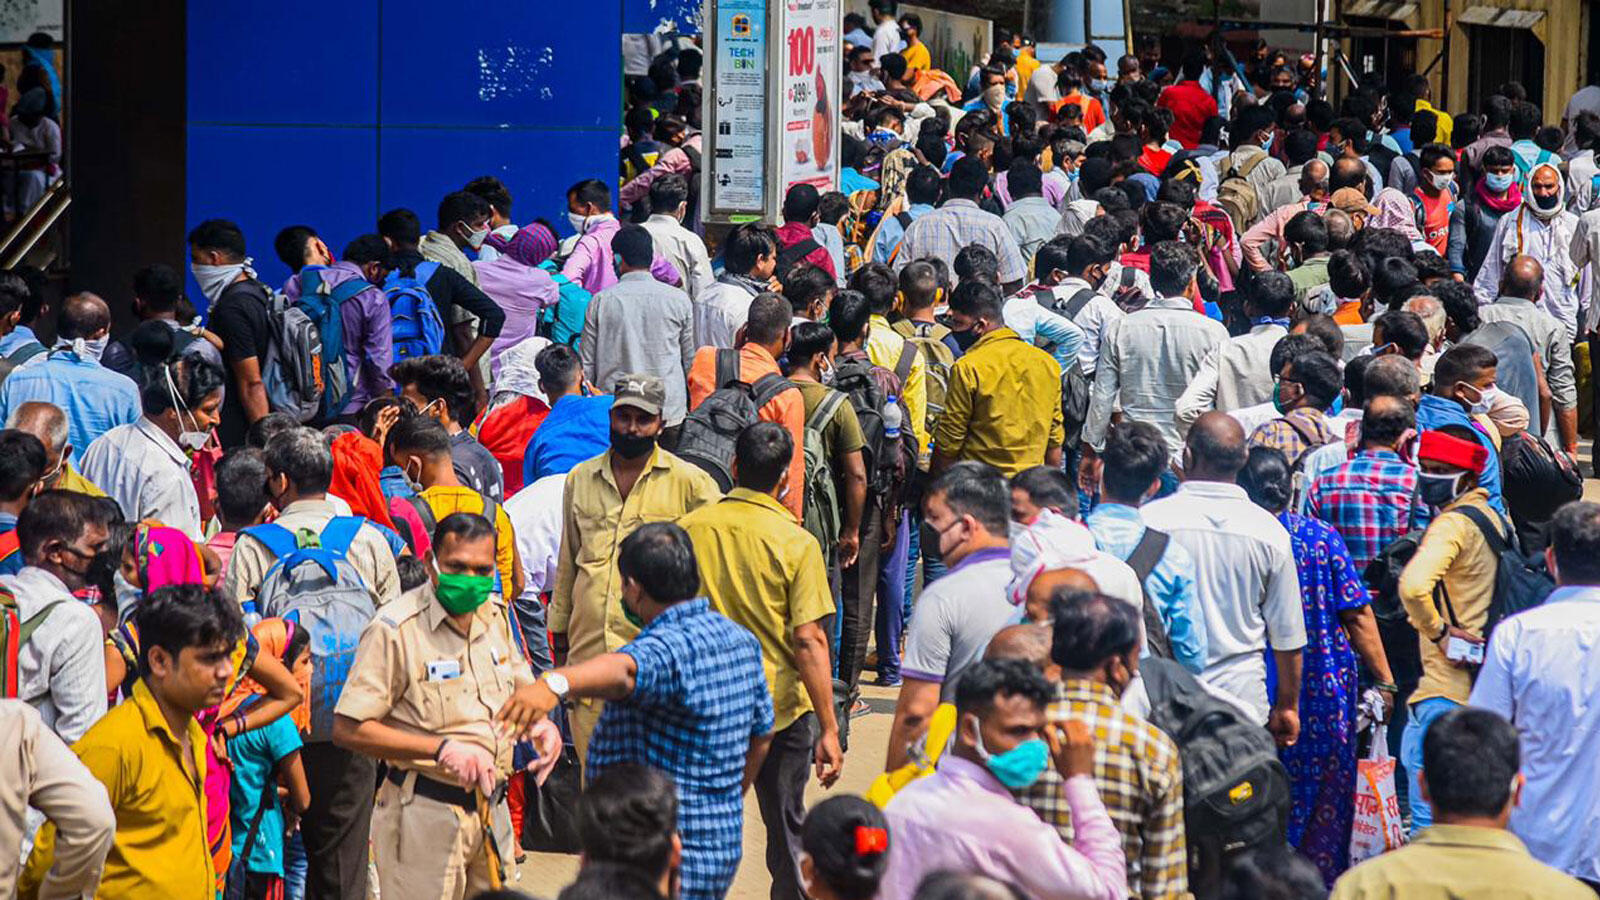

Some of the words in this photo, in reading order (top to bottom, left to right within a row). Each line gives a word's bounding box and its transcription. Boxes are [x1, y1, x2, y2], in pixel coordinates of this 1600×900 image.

[729, 47, 755, 57] TECH
[788, 26, 814, 76] 100
[734, 59, 755, 69] BIN
